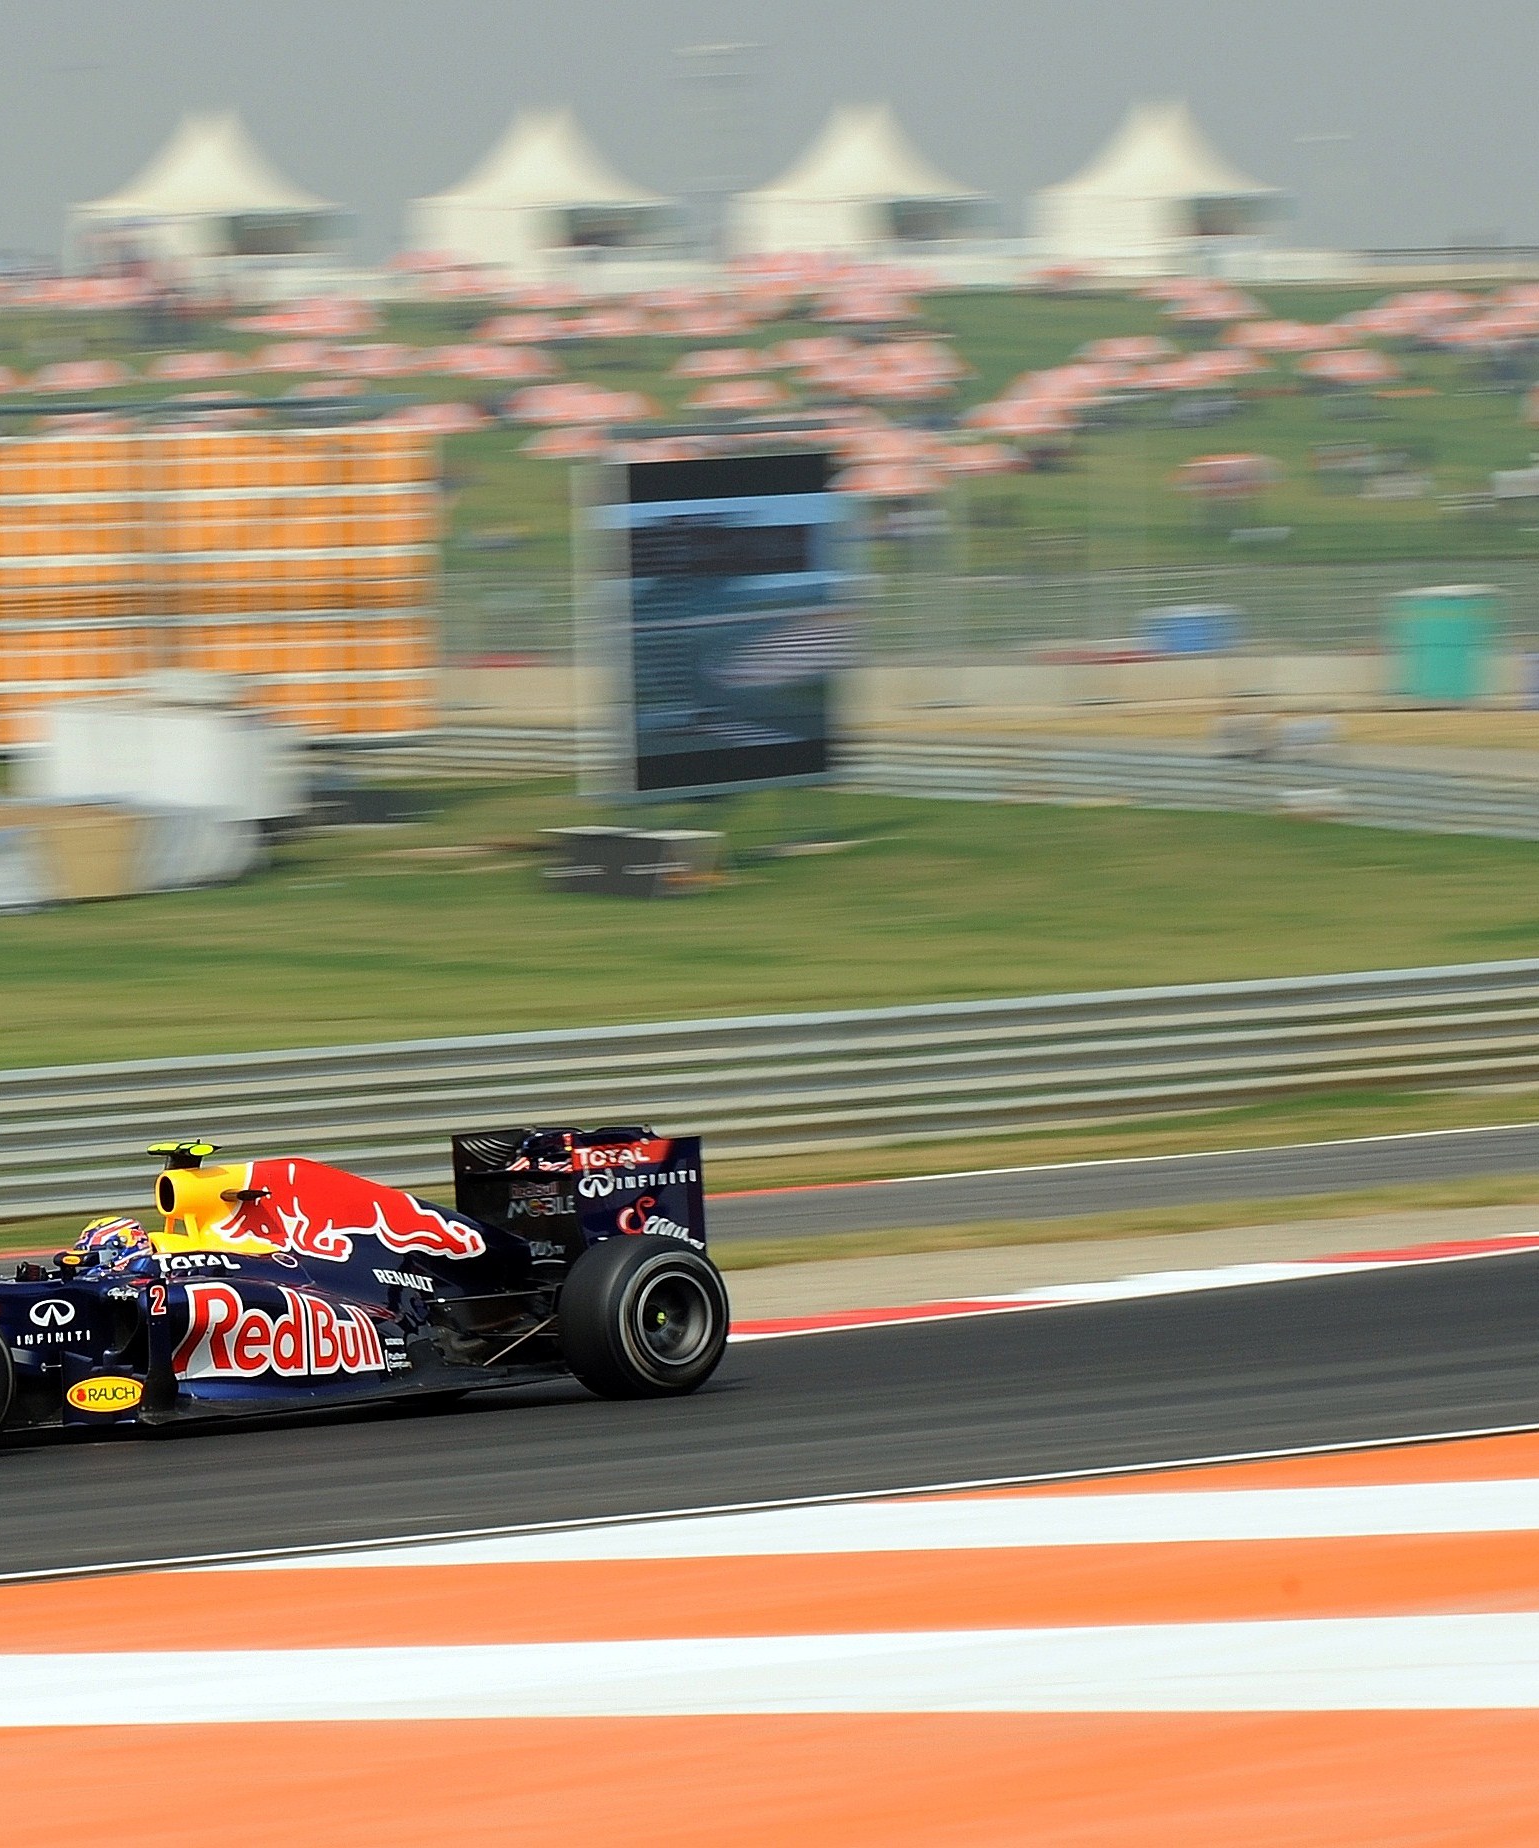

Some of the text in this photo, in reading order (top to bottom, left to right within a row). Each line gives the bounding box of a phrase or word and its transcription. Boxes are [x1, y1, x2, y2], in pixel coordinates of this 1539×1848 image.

[574, 1146, 651, 1168] TOTAL
[616, 1168, 696, 1191] INFINITI
[152, 1254, 241, 1277] TOTAL
[372, 1268, 434, 1293] RENAULT
[150, 1285, 167, 1316] 2
[16, 1330, 91, 1346] INFINITI
[88, 1387, 135, 1402] RAUCH
